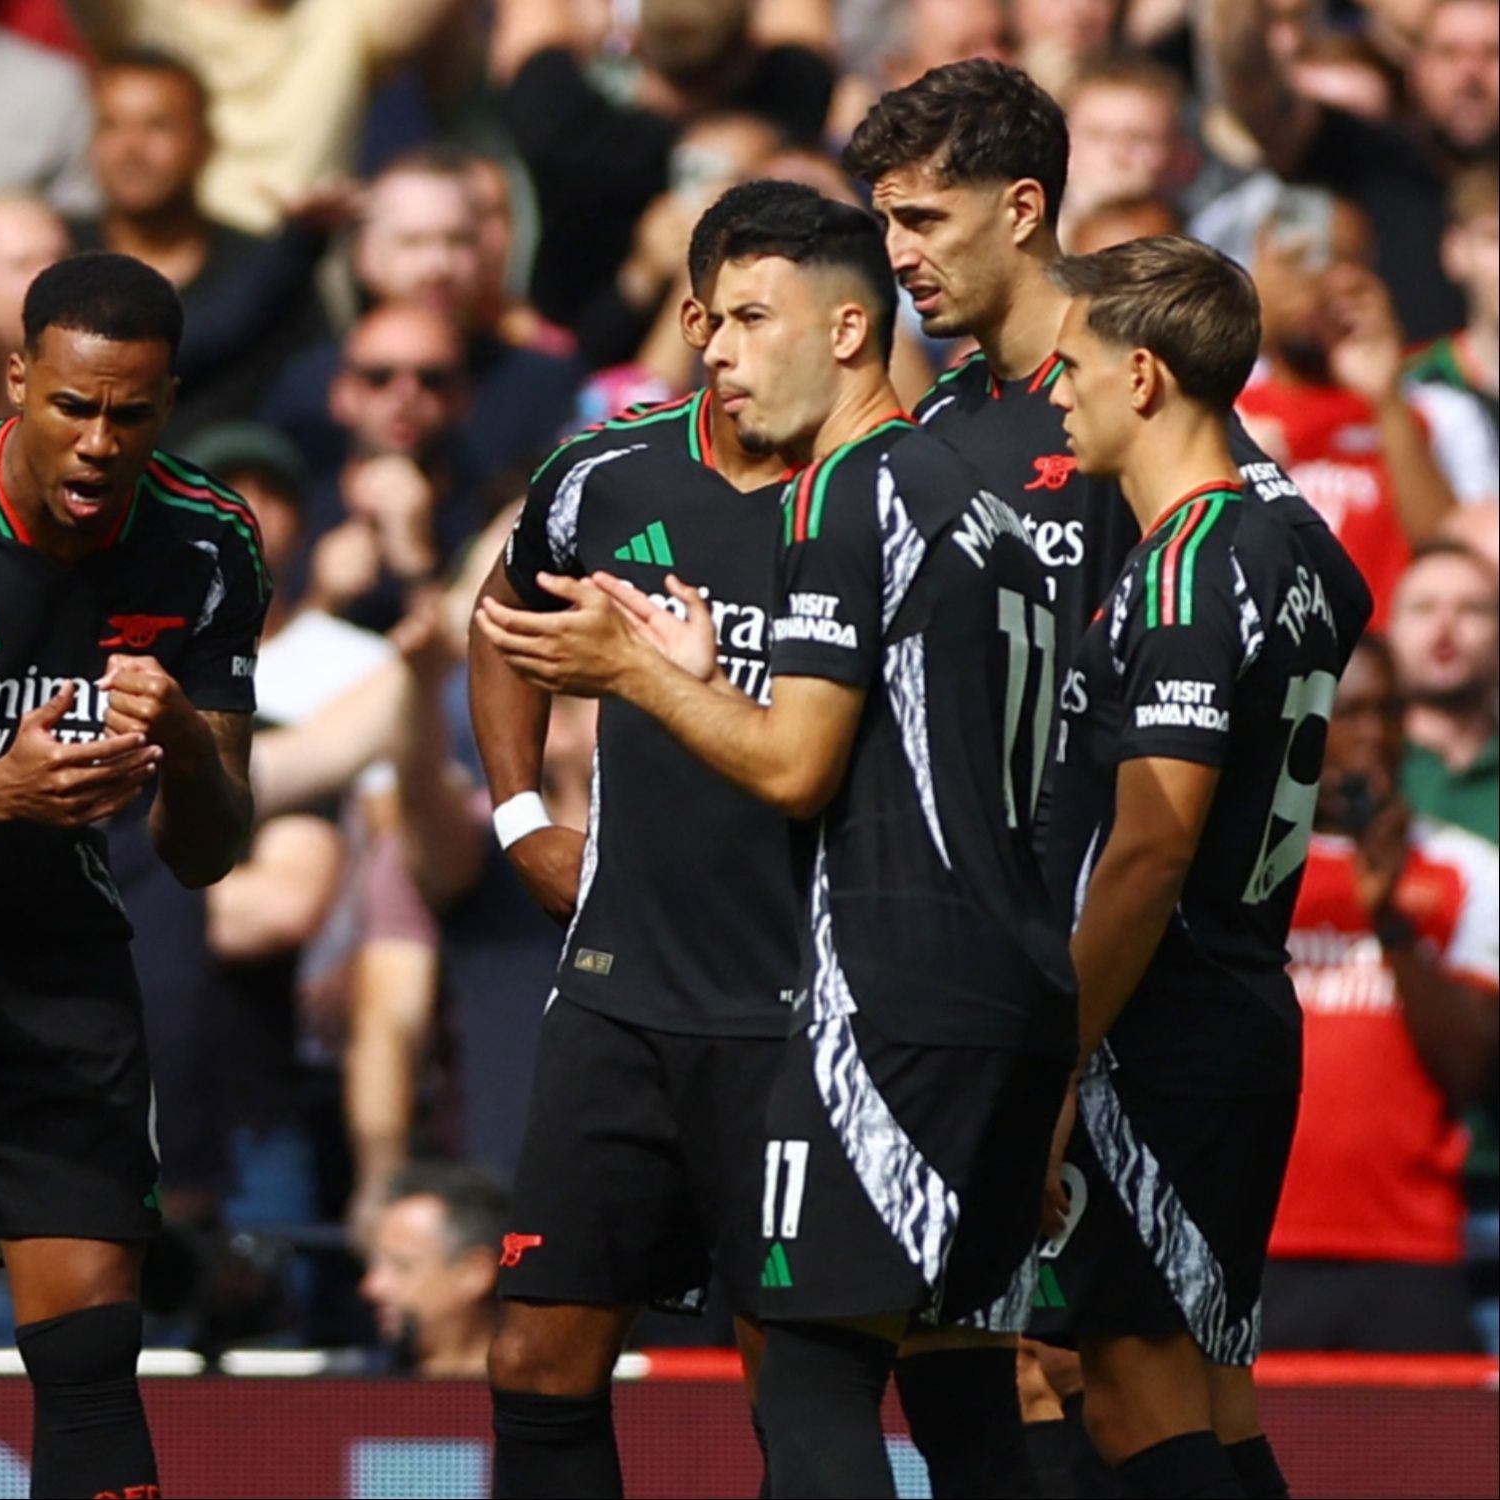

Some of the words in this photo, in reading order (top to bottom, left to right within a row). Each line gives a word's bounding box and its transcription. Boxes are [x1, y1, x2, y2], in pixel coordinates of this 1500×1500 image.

[788, 593, 840, 619] VISIT
[772, 616, 858, 649] RWANDA
[997, 586, 1057, 829] 11
[1154, 680, 1217, 704] VISIT
[1135, 703, 1230, 733] RWANDA
[762, 1140, 810, 1239] 11
